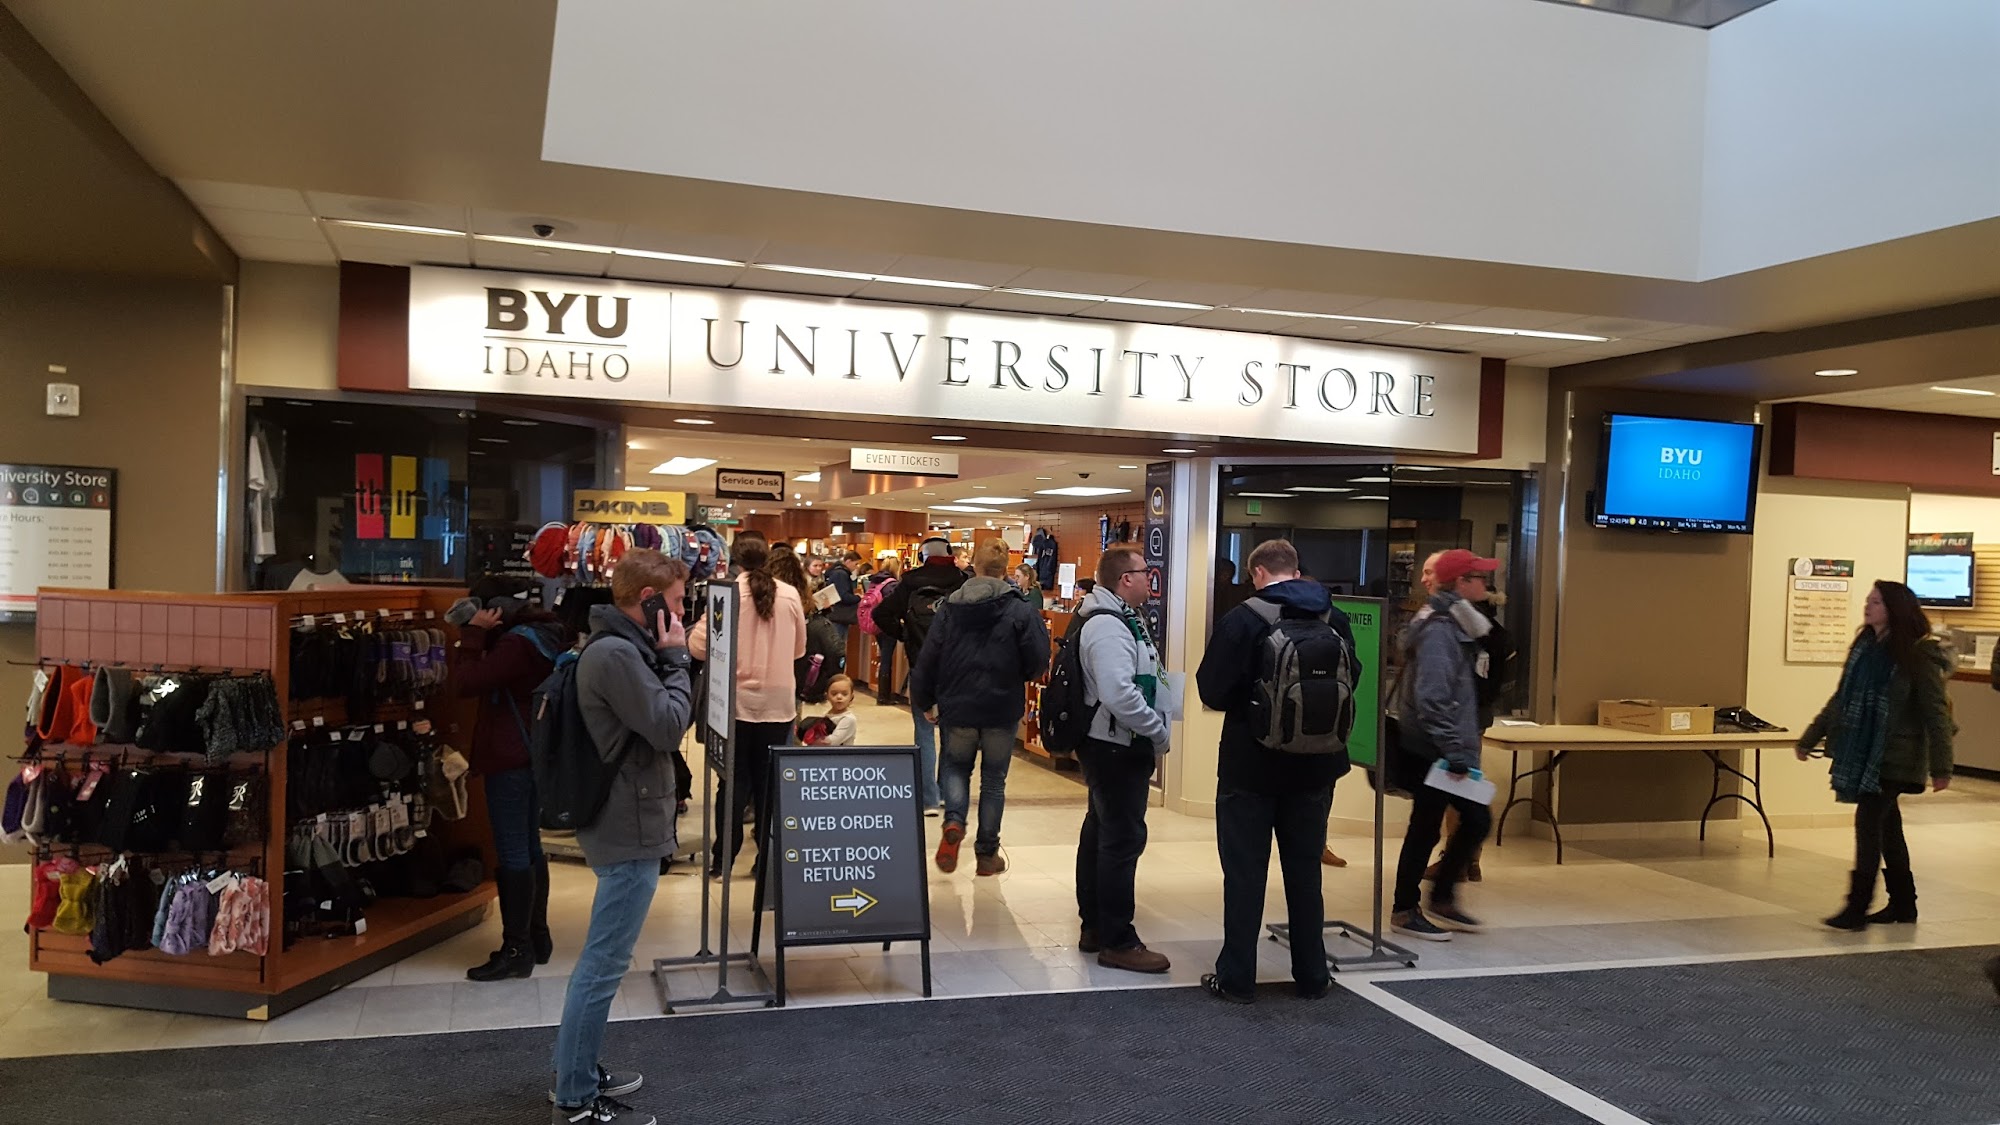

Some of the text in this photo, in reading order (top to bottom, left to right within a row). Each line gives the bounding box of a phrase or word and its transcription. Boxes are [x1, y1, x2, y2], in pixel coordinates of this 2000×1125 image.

[483, 286, 632, 339] BYU
[482, 345, 630, 382] IDAHO
[700, 318, 1436, 419] UNIVERSITY STORE
[866, 453, 941, 467] EVENT TICKETS
[1660, 447, 1703, 465] BYU
[65, 471, 108, 488] Store
[721, 475, 780, 488] Service Desk
[1658, 467, 1702, 481] IDAHO
[577, 500, 672, 517] DAKINE
[1344, 612, 1372, 626] RINTER
[799, 767, 886, 782] TEXT BOOK
[801, 784, 913, 801] RESERVATIONS
[801, 815, 894, 831] WEB ORDER
[802, 846, 891, 863] TEXT BOOK
[803, 865, 875, 882] RETURNS
